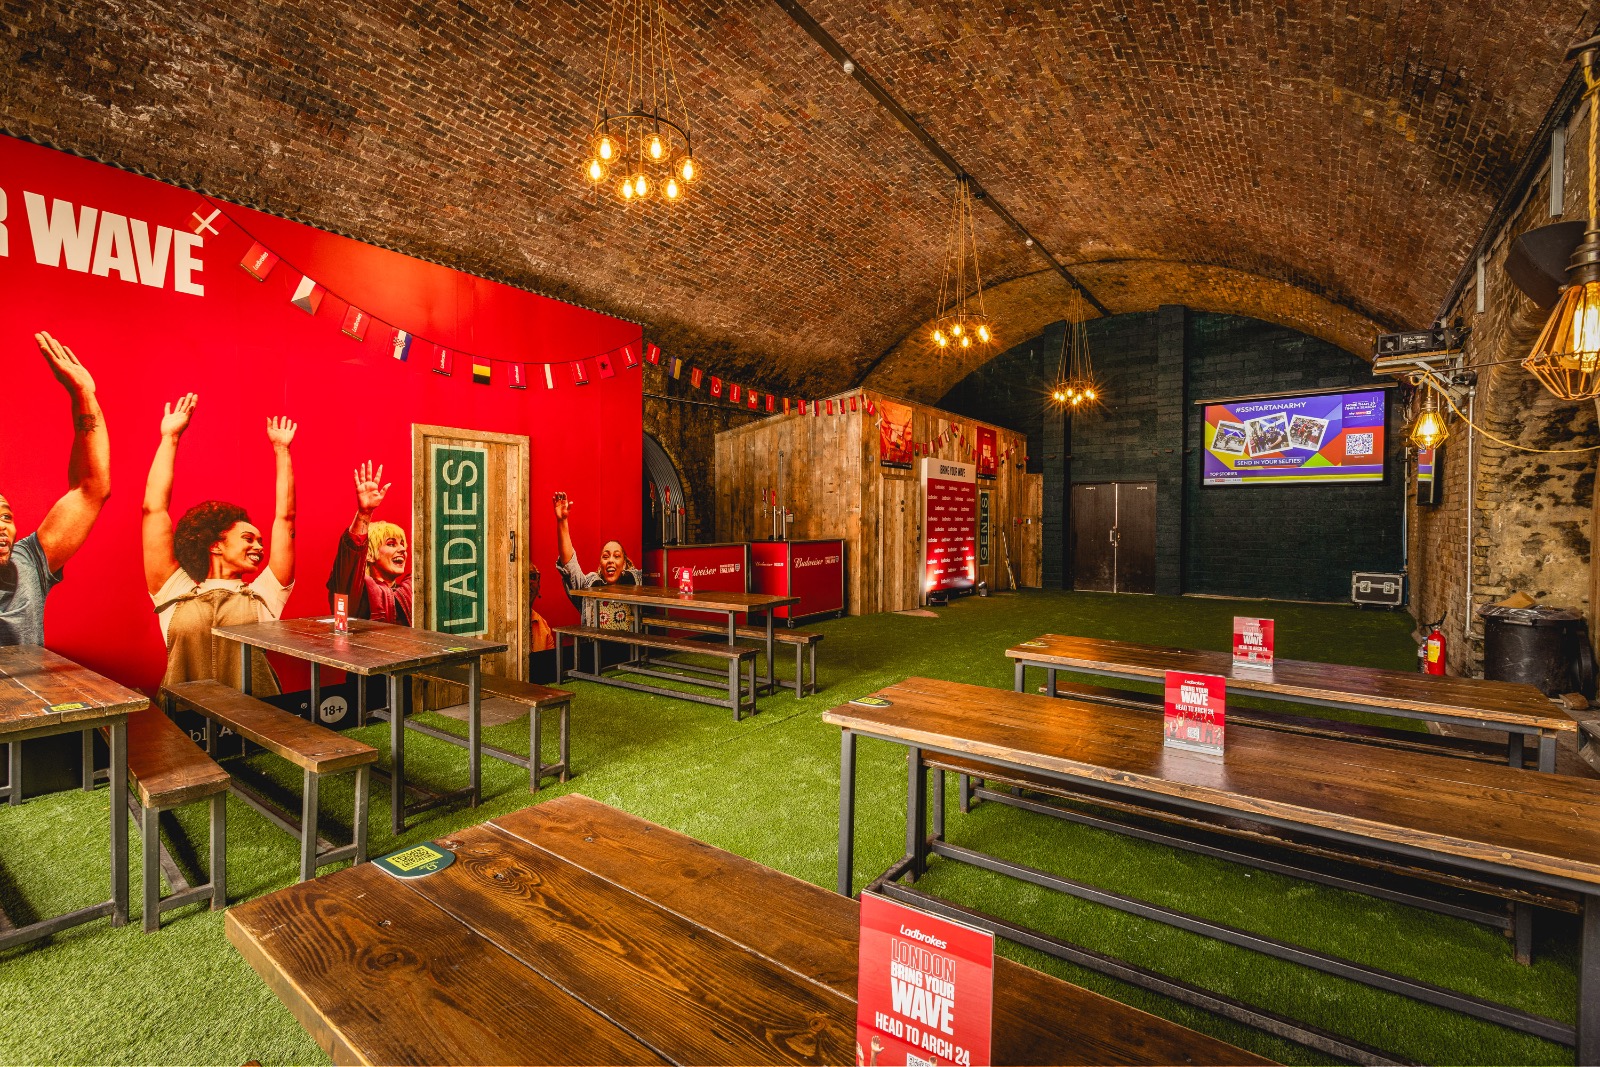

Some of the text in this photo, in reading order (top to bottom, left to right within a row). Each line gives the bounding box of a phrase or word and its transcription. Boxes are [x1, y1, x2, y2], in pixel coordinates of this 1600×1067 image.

[23, 190, 204, 296] WAVE
[1236, 402, 1306, 413] #SSNTARTANARMY
[442, 460, 478, 626] LADIES
[794, 557, 824, 568] Budweiser
[1244, 635, 1262, 646] WAVE
[323, 705, 344, 716] 18+
[1181, 691, 1208, 706] WAVE
[900, 924, 947, 950] Ladbrokes
[892, 938, 956, 984] LONDON
[891, 961, 954, 1000] BRING YOUR
[891, 976, 954, 1036] WAVE
[876, 1011, 970, 1067] HEAD TO ARCH 24
